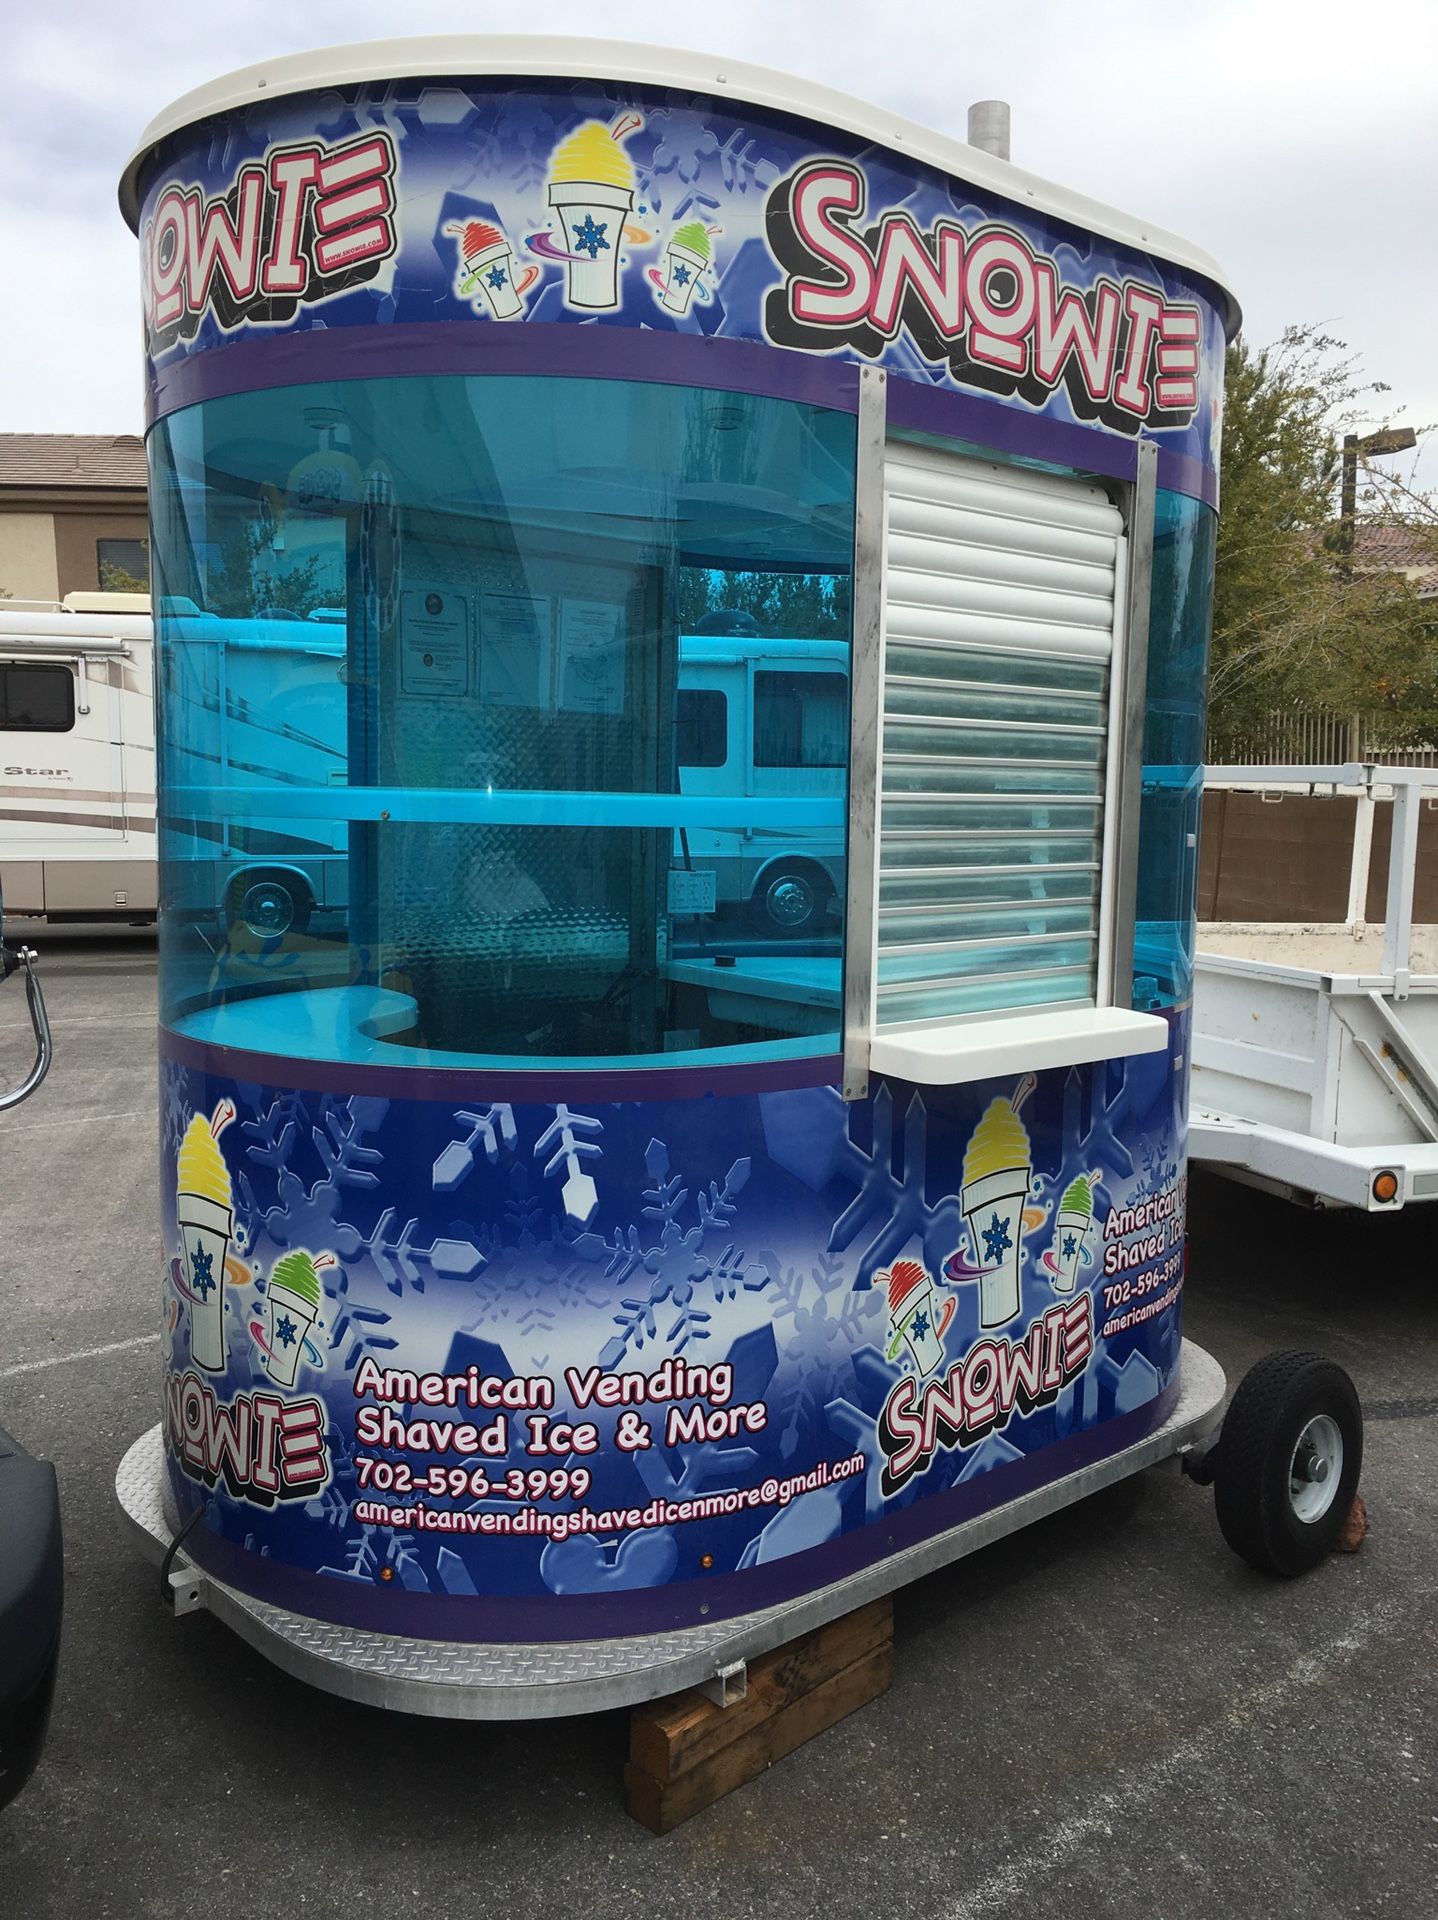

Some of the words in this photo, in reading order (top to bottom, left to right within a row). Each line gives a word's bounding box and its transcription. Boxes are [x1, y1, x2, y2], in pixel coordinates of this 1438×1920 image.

[786, 160, 1201, 418] SNOWIE
[4, 766, 69, 776] Star
[1103, 1189, 1176, 1241] American
[1103, 1221, 1166, 1276] Shaved
[1103, 1251, 1181, 1310] 702-596-3999
[355, 1357, 554, 1408] American
[565, 1357, 734, 1407] Vending
[884, 1292, 1093, 1479] SNOWIE
[354, 1405, 509, 1456] Shaved
[526, 1415, 599, 1455] Ice
[616, 1411, 651, 1451] &
[666, 1402, 767, 1447] More
[353, 1456, 591, 1500] 702-596-3999
[353, 1452, 866, 1541] americanvendingshavedicenmore@gmail.com
